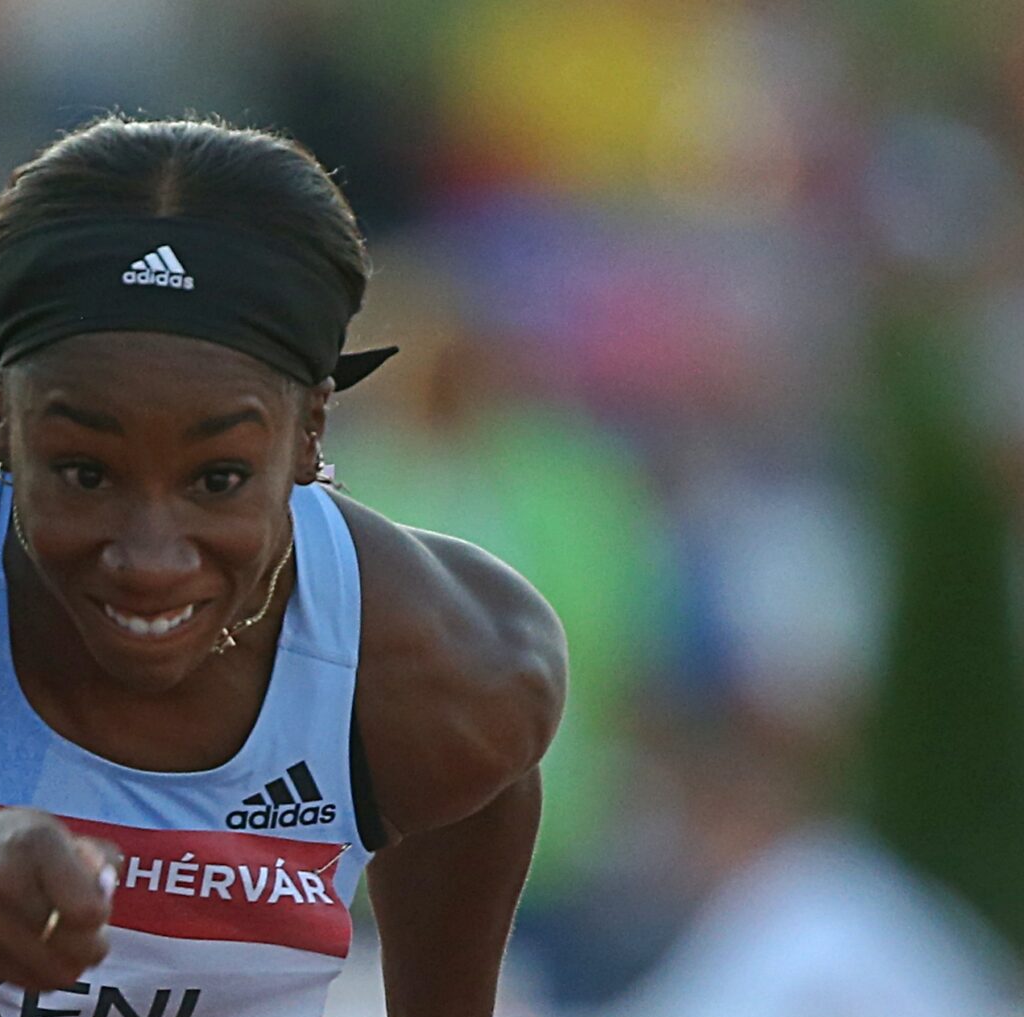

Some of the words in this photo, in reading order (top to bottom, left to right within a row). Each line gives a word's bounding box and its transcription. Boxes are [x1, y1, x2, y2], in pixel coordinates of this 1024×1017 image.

[122, 270, 195, 290] adidas
[225, 803, 336, 830] adidas
[117, 852, 334, 905] HÉRVÁR
